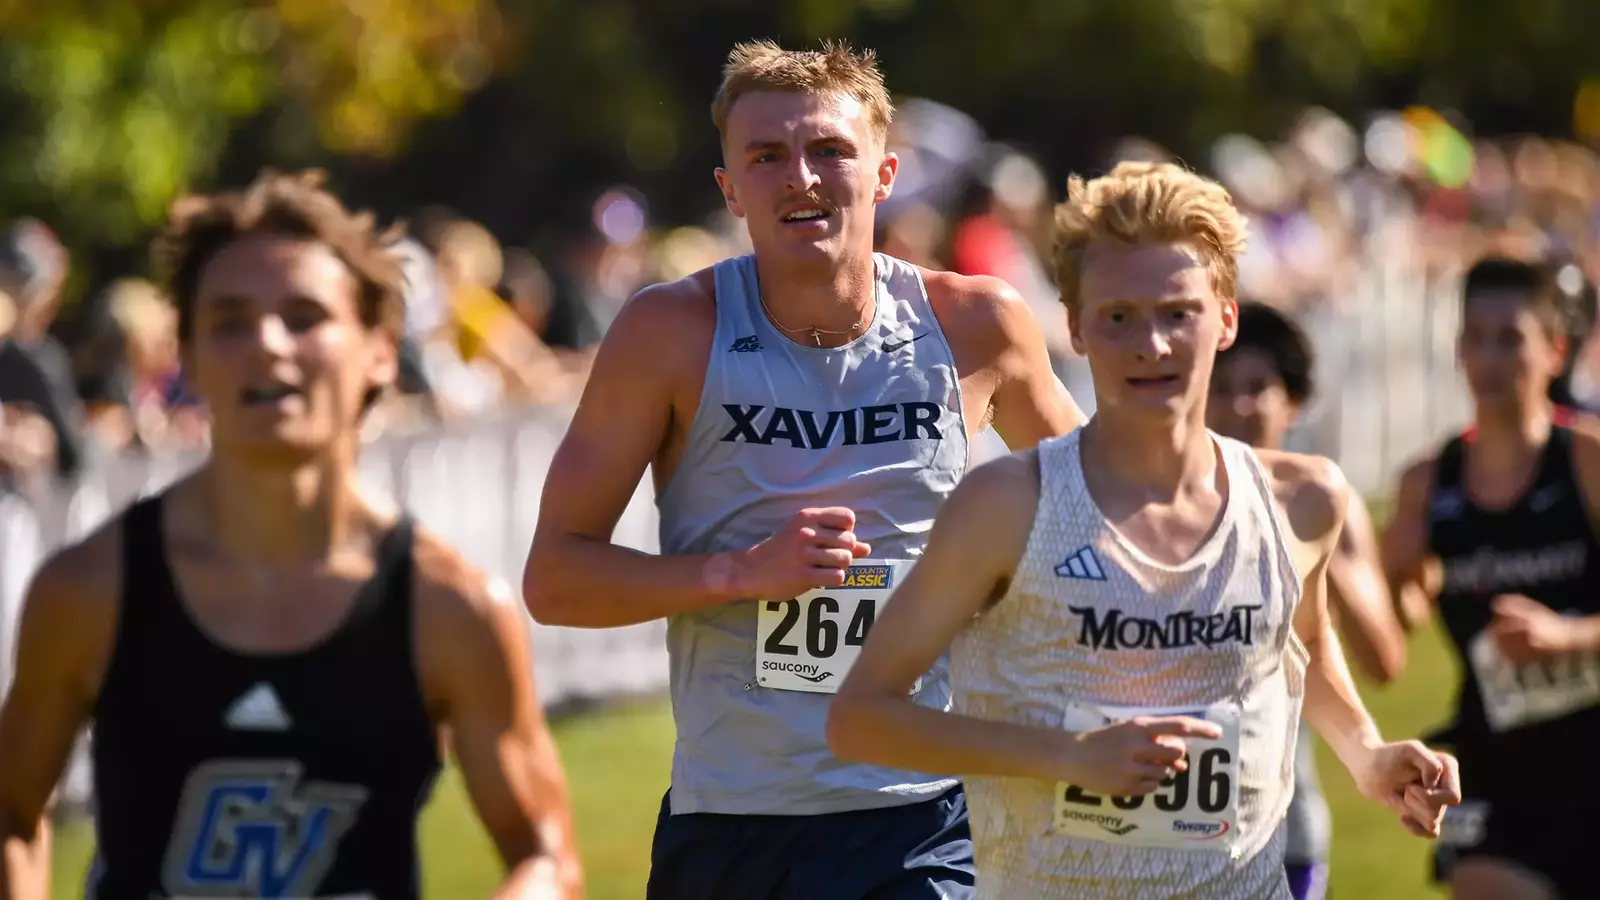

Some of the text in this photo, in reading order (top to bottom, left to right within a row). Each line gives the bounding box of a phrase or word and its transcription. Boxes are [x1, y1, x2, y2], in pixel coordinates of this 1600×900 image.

[720, 402, 943, 450] XAVIER
[855, 567, 889, 575] COUNTRY
[839, 574, 887, 587] ASSIC
[764, 597, 876, 658] 264
[762, 661, 819, 675] saucony
[1064, 747, 1231, 813] 96
[1062, 809, 1123, 825] saucony
